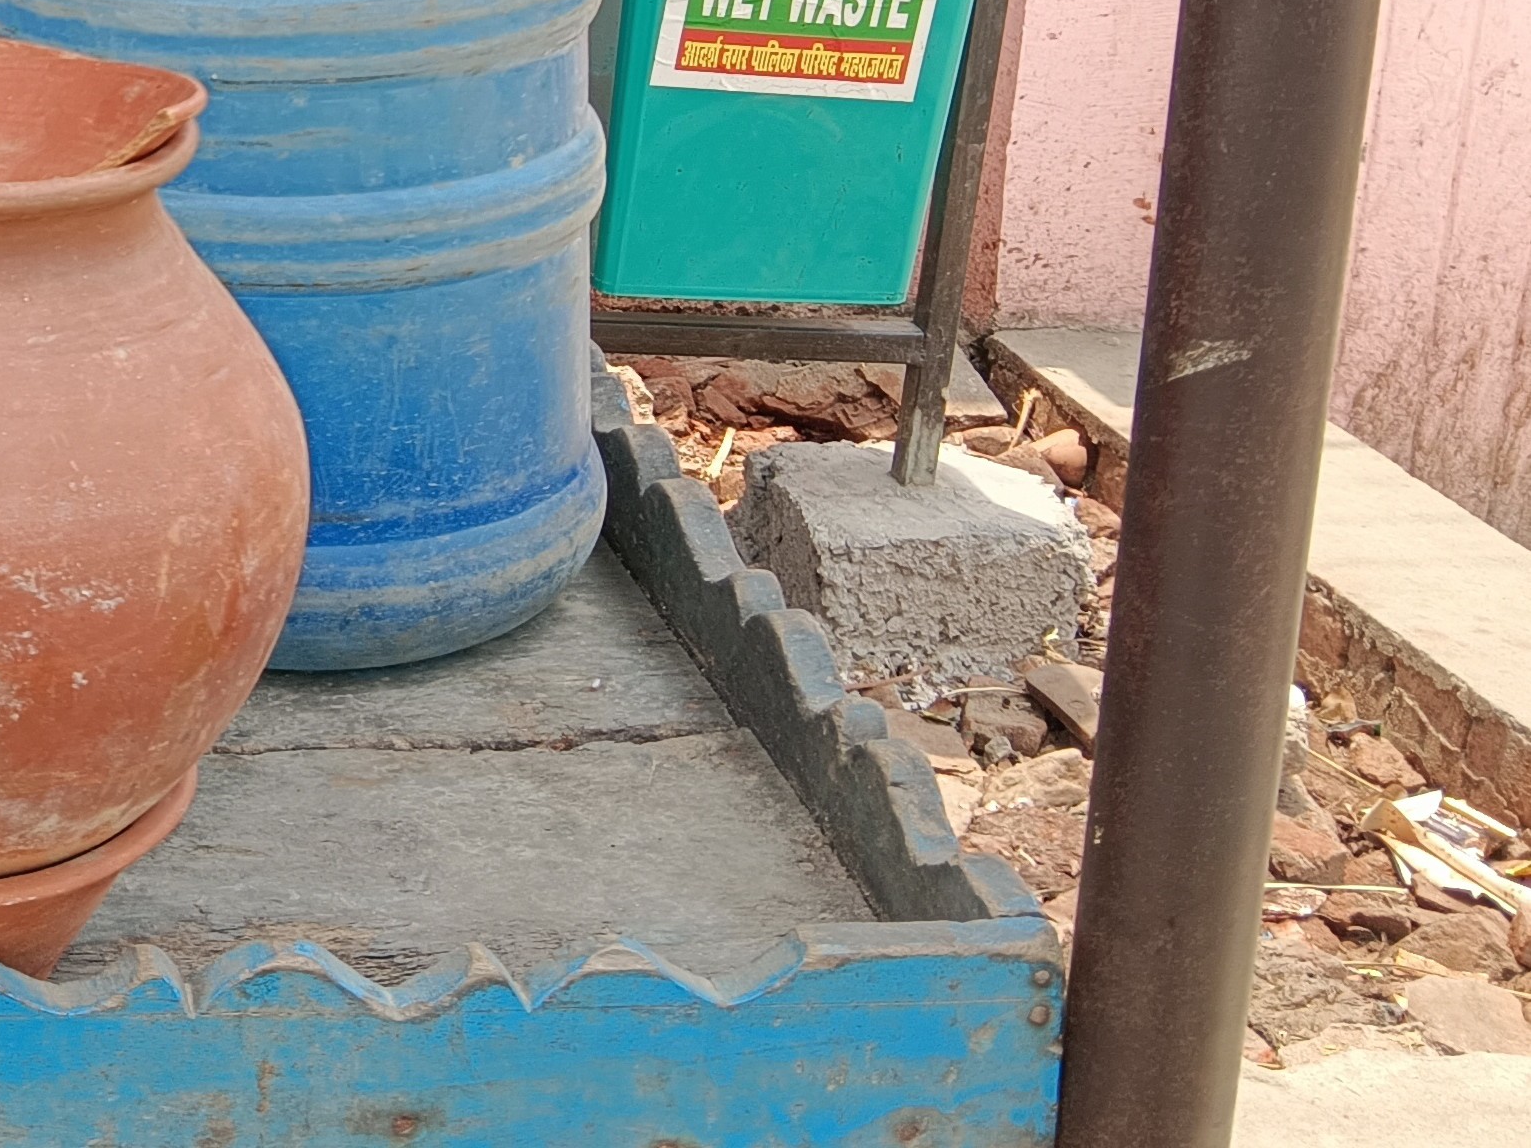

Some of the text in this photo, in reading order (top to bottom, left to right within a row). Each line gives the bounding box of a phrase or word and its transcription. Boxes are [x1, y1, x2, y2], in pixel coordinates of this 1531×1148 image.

[680, 35, 905, 80] आदर्श नगर पालिका परिषद महराजगंज
